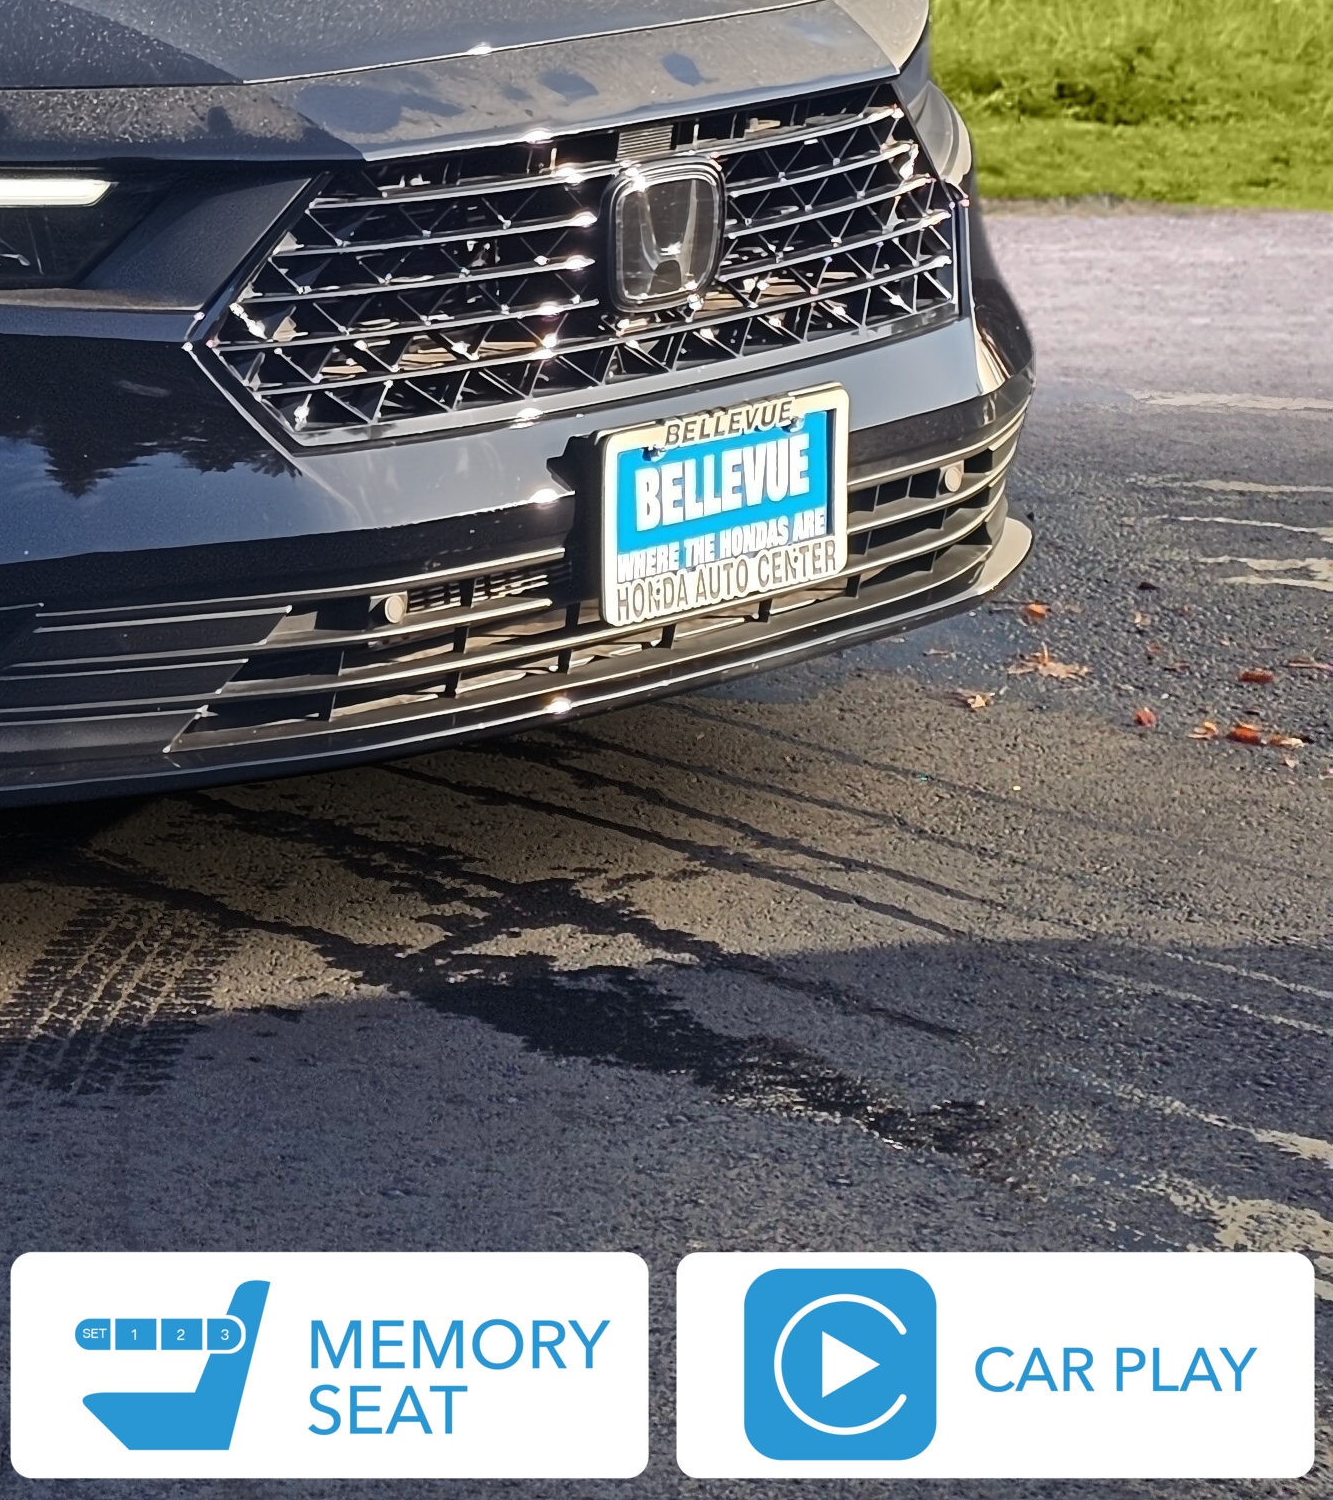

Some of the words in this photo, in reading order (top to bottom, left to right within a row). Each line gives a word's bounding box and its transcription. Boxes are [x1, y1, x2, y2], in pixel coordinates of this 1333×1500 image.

[664, 399, 794, 447] BELLEVUE
[635, 432, 811, 532] BELLEVUE
[617, 541, 680, 585] WHERE
[683, 533, 716, 568] THE
[720, 515, 790, 558] HONDAS
[792, 506, 827, 542] ARE
[617, 573, 689, 622] HONDA
[695, 558, 749, 604] AUTO
[757, 539, 837, 588] CENTER
